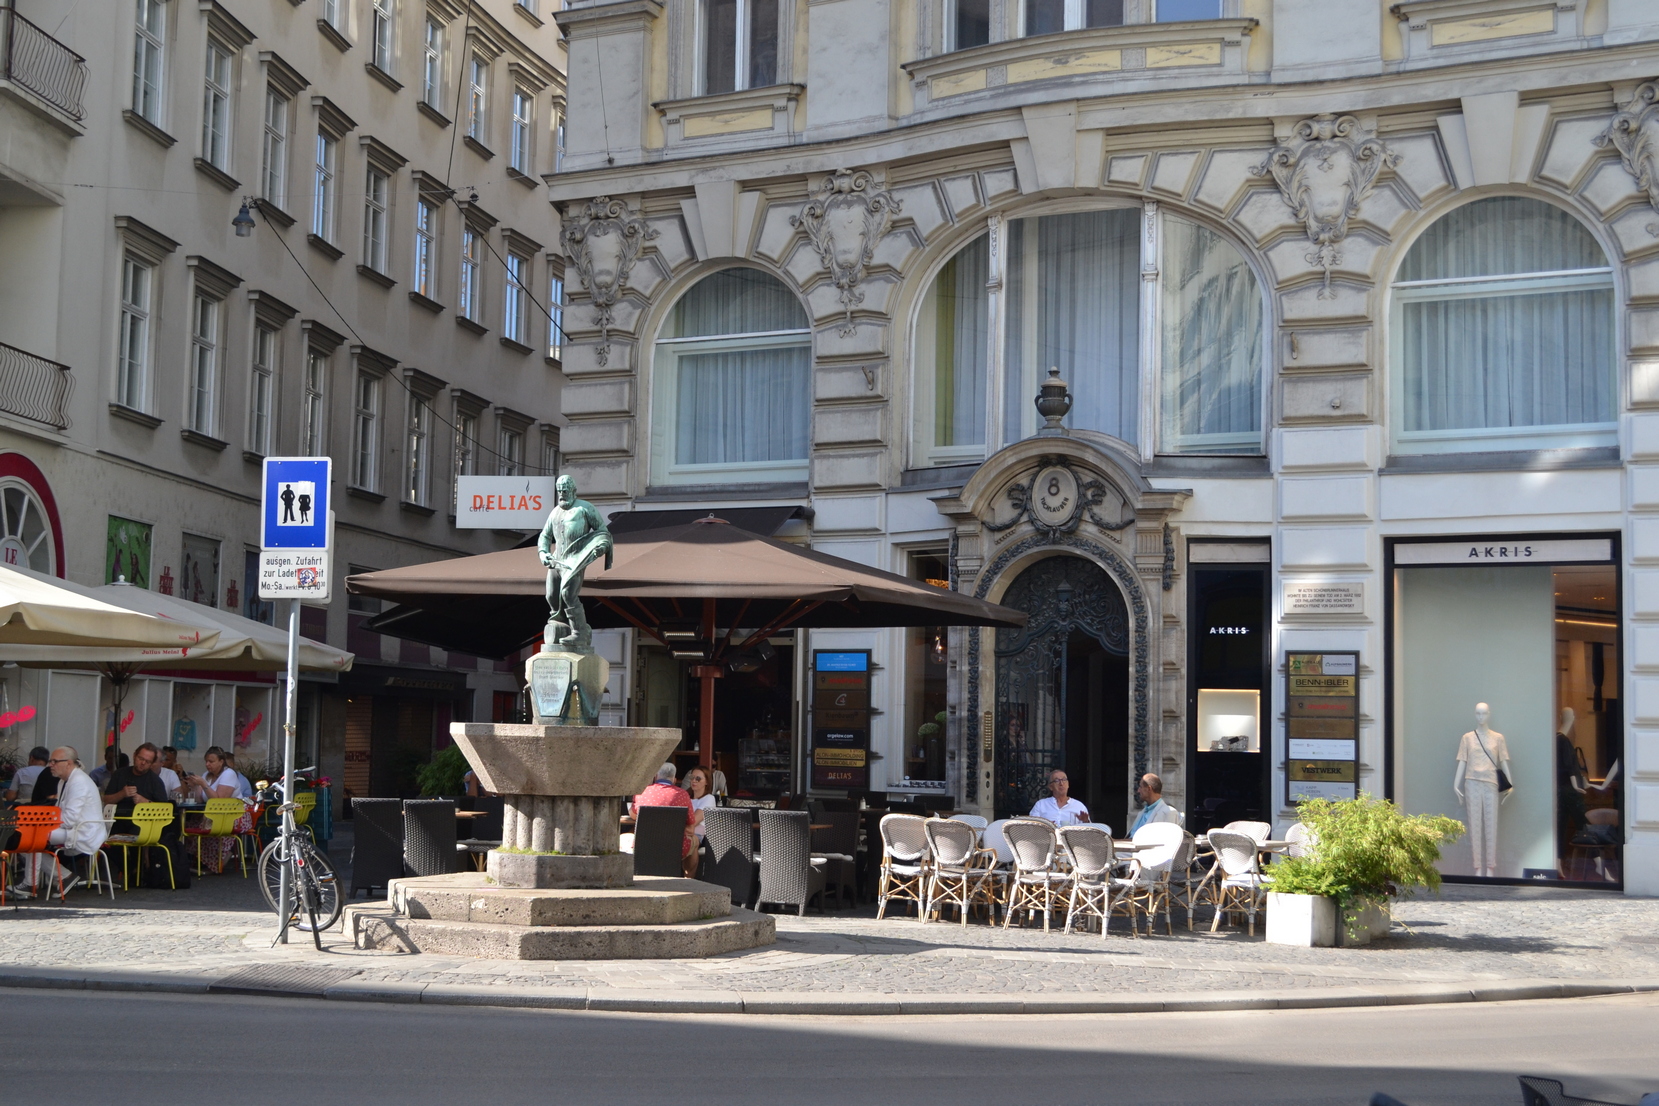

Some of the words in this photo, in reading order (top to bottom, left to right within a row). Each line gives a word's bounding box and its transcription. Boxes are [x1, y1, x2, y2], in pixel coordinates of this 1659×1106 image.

[1047, 476, 1060, 497] 8
[472, 494, 543, 511] DELIA'S
[265, 558, 293, 567] ausgen.
[295, 556, 322, 566] Zufahrt
[263, 570, 276, 578] zur
[277, 568, 324, 578] Ladeteit
